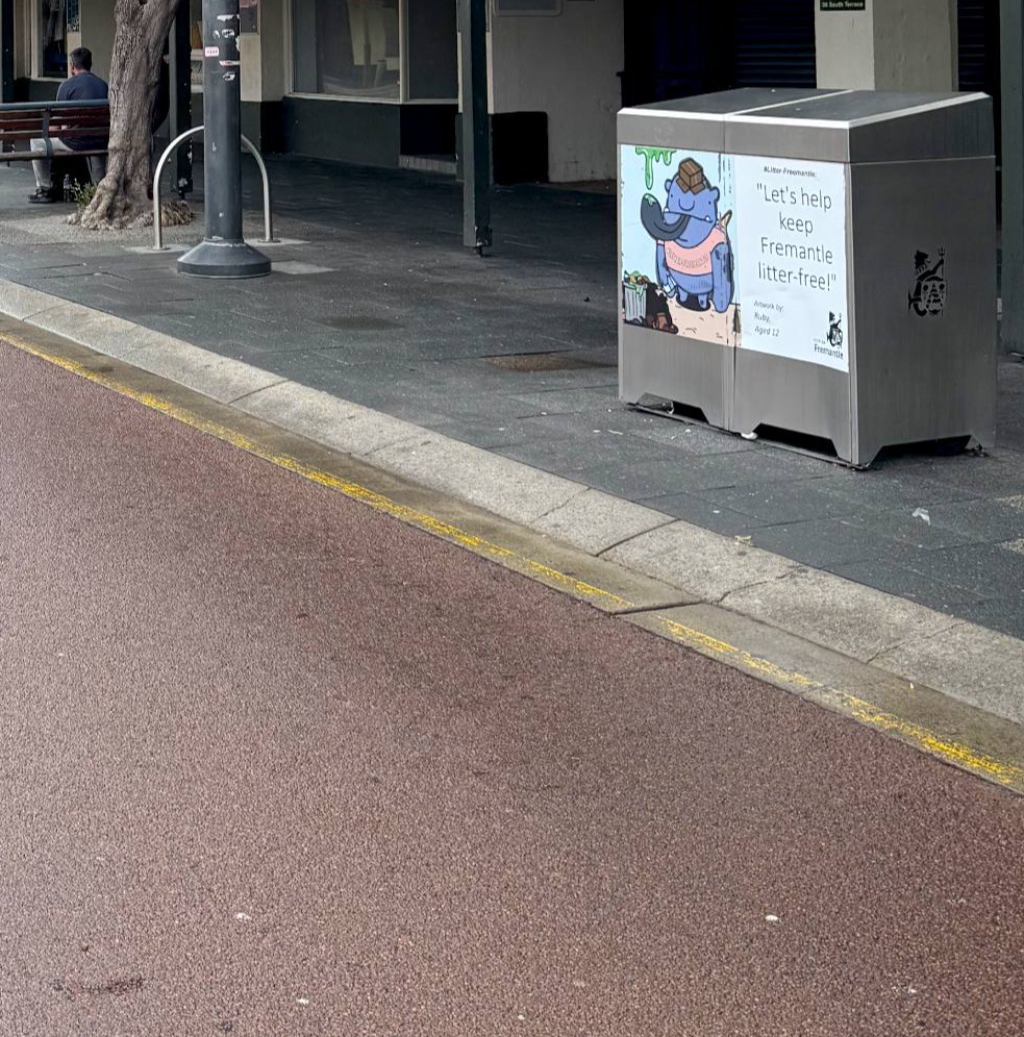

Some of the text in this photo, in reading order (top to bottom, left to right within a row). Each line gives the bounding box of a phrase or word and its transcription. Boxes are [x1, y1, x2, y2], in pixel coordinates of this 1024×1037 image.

[756, 182, 833, 213] "Let's help
[778, 211, 814, 237] keep
[760, 236, 834, 265] Fremantle
[758, 261, 837, 292] litter-free!"
[753, 299, 775, 310] Artwork
[754, 324, 780, 337] Aged 12
[813, 343, 844, 360] Fremantle
